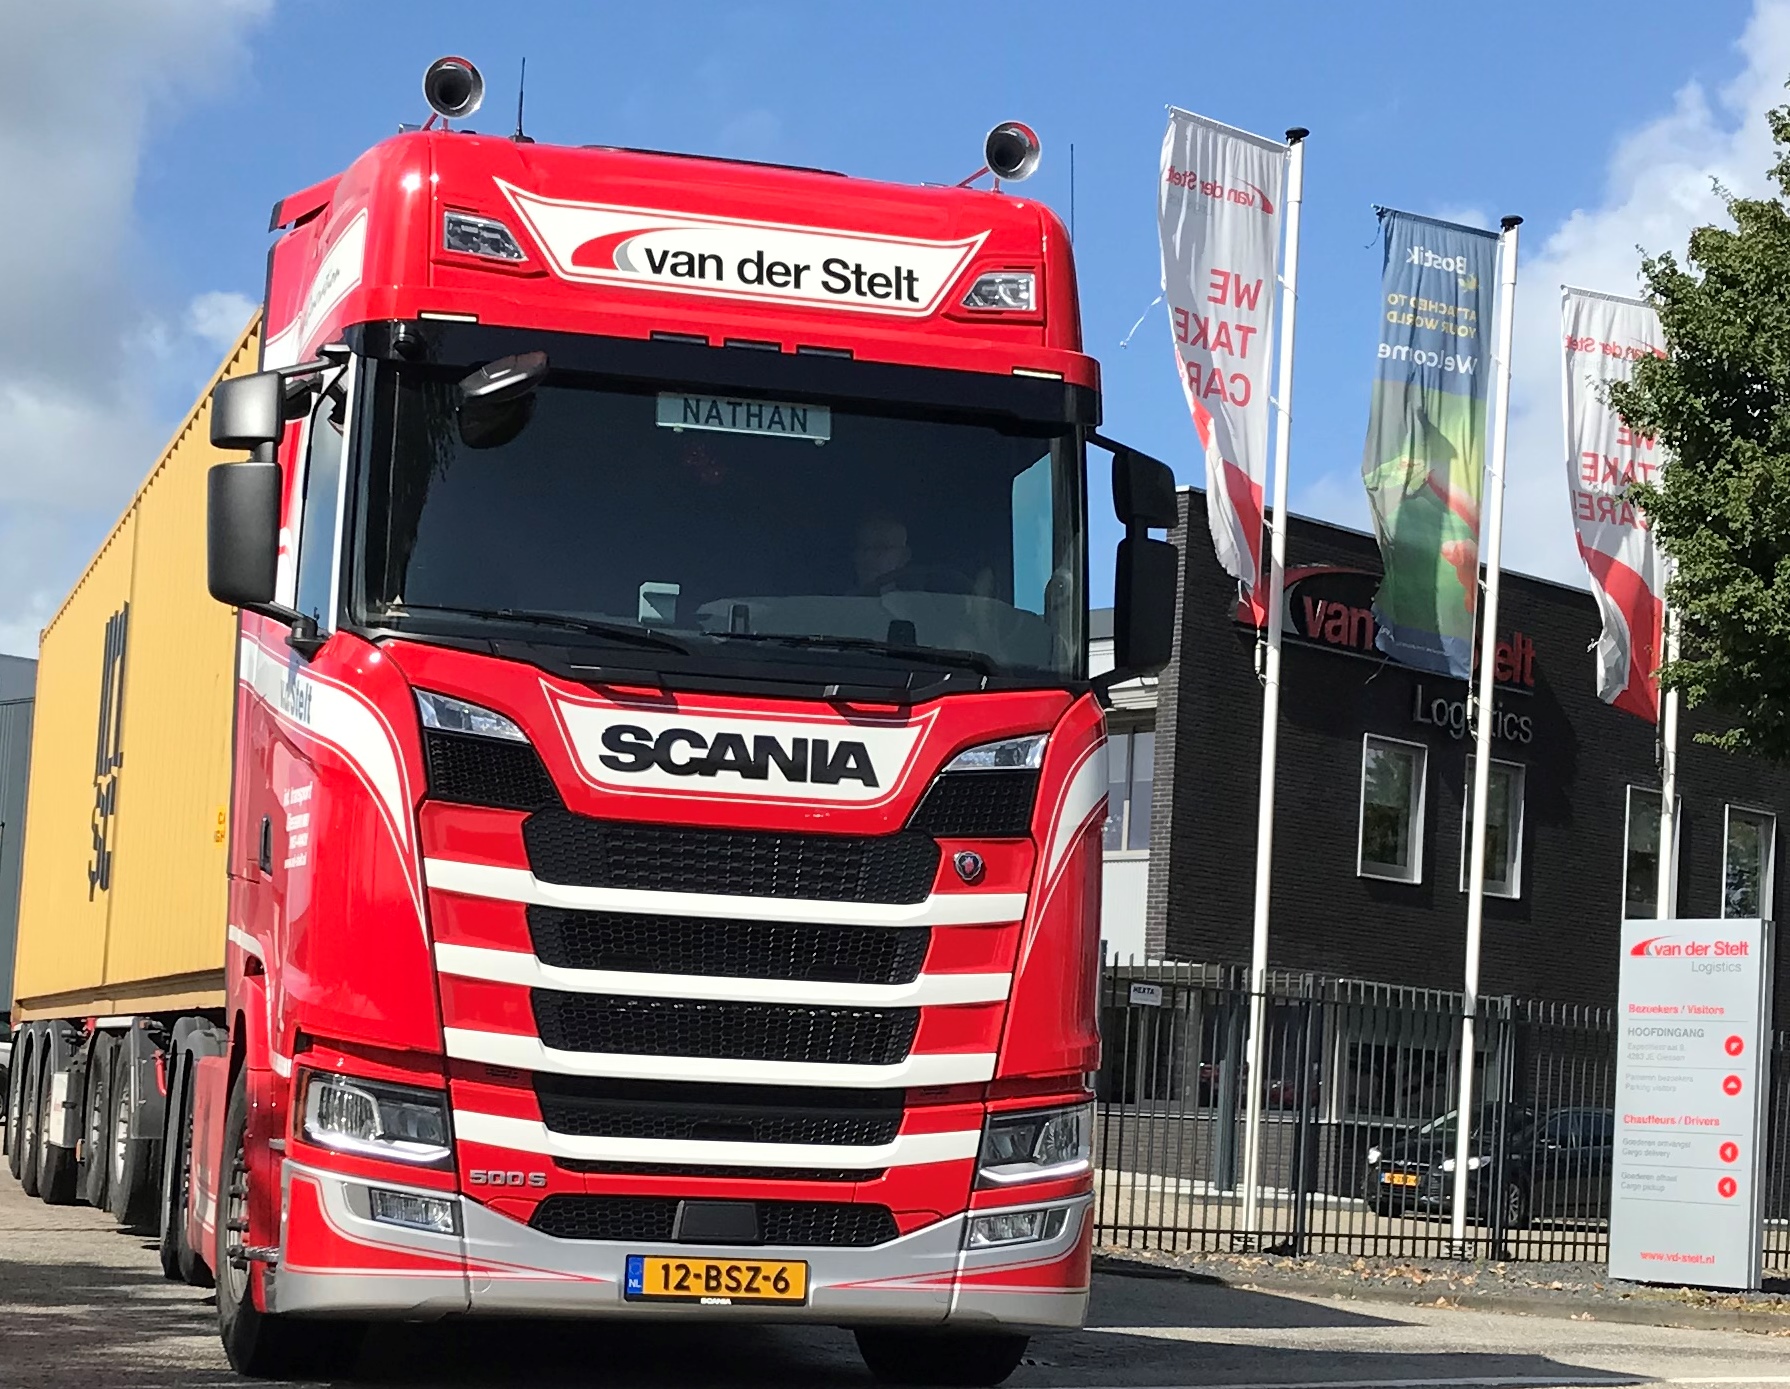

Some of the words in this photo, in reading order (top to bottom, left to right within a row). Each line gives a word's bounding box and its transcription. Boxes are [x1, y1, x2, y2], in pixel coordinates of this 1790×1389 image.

[643, 247, 724, 281] van
[737, 250, 811, 290] der
[820, 257, 920, 303] Stelt
[681, 397, 809, 433] NATHAN
[1303, 596, 1375, 650] van
[598, 724, 881, 790] SCANIA
[1654, 944, 1682, 956] van
[1685, 941, 1711, 956] der
[1714, 940, 1750, 957] Stelt
[1691, 961, 1742, 975] Logistics
[1687, 1005, 1725, 1015] Visitors
[1627, 1027, 1705, 1038] HOOFDINGANG
[1623, 1114, 1676, 1126] Chauffeurs
[1684, 1116, 1720, 1127] Drivers
[1622, 1148, 1643, 1158] Cargo
[1644, 1149, 1671, 1159] delivery
[469, 1169, 525, 1187] 500
[528, 1172, 547, 1188] S
[1640, 1251, 1716, 1265] www.vd-stelt.nl
[628, 1279, 642, 1290] NL
[660, 1263, 792, 1295] 12-BSZ-6
